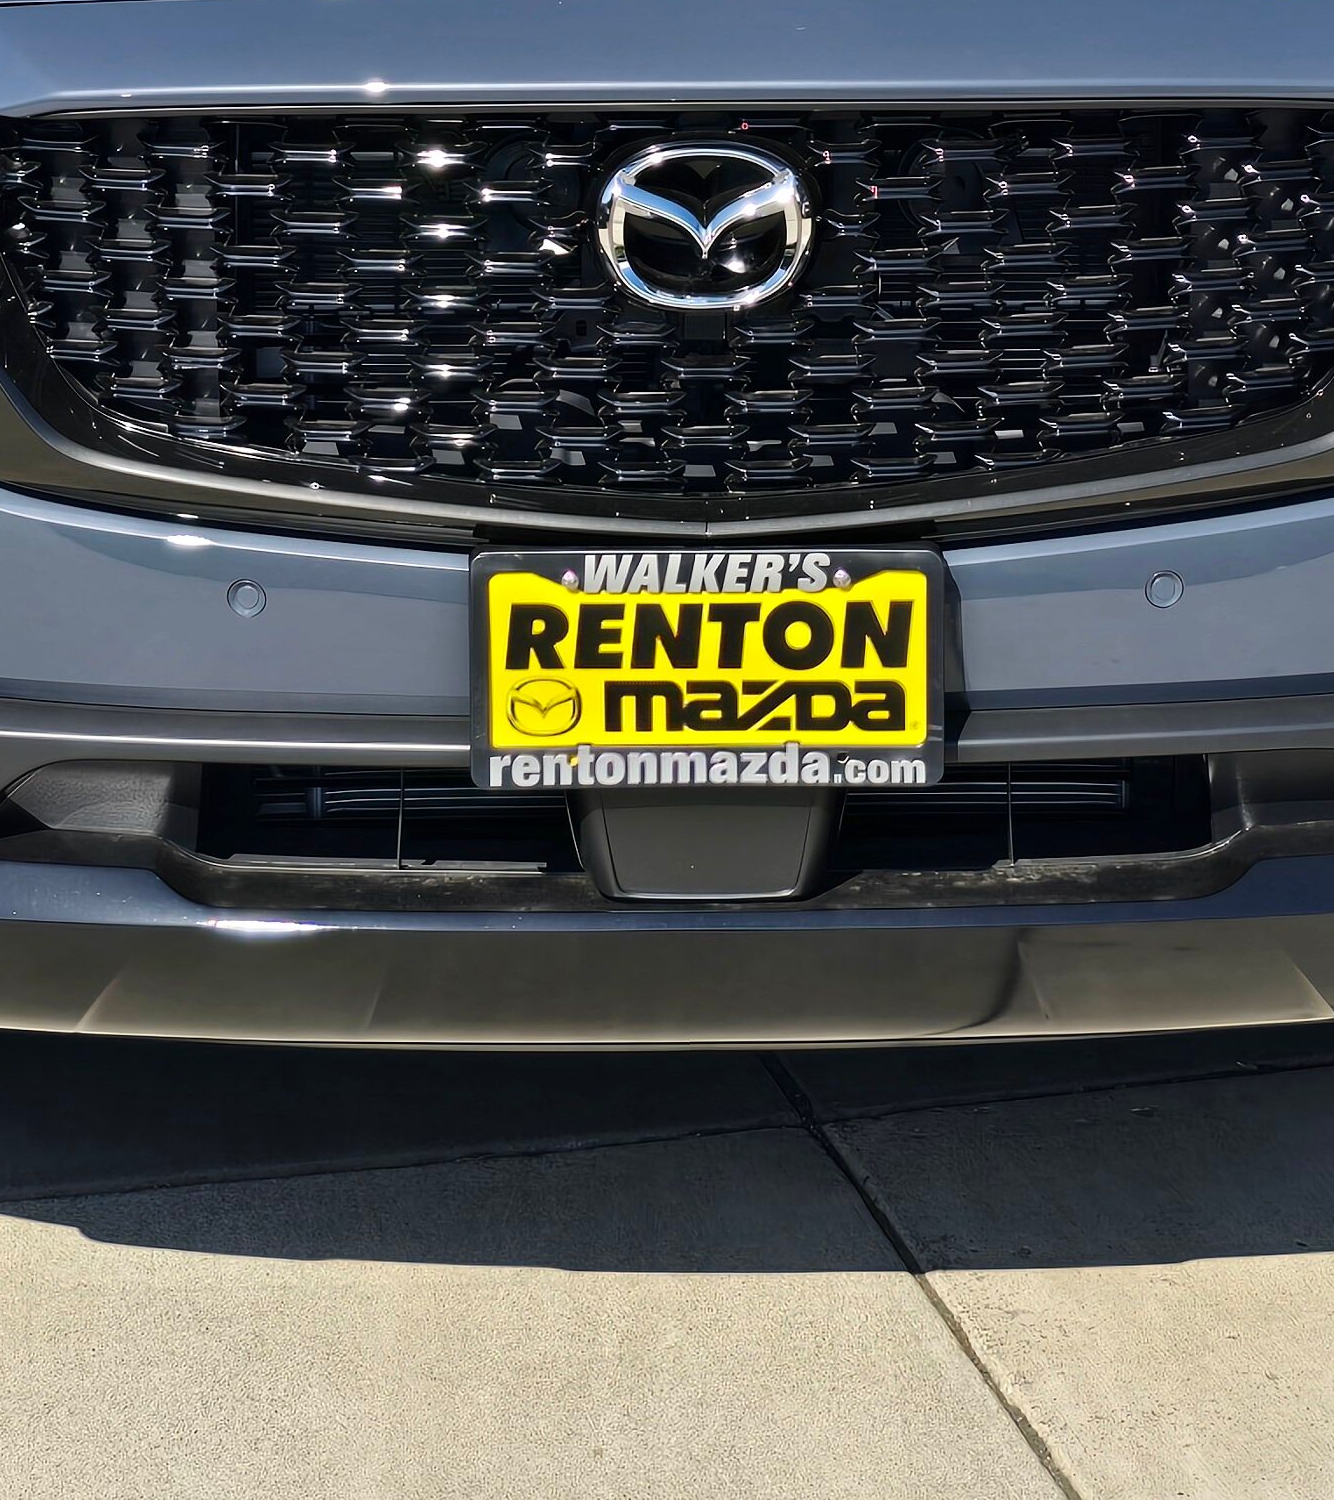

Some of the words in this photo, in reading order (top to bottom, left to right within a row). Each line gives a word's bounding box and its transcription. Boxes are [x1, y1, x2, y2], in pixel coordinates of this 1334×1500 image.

[583, 553, 832, 595] WALKER'S
[504, 600, 913, 671] RENTON
[603, 680, 906, 732] mazda
[489, 743, 927, 788] rentonmazda.com
